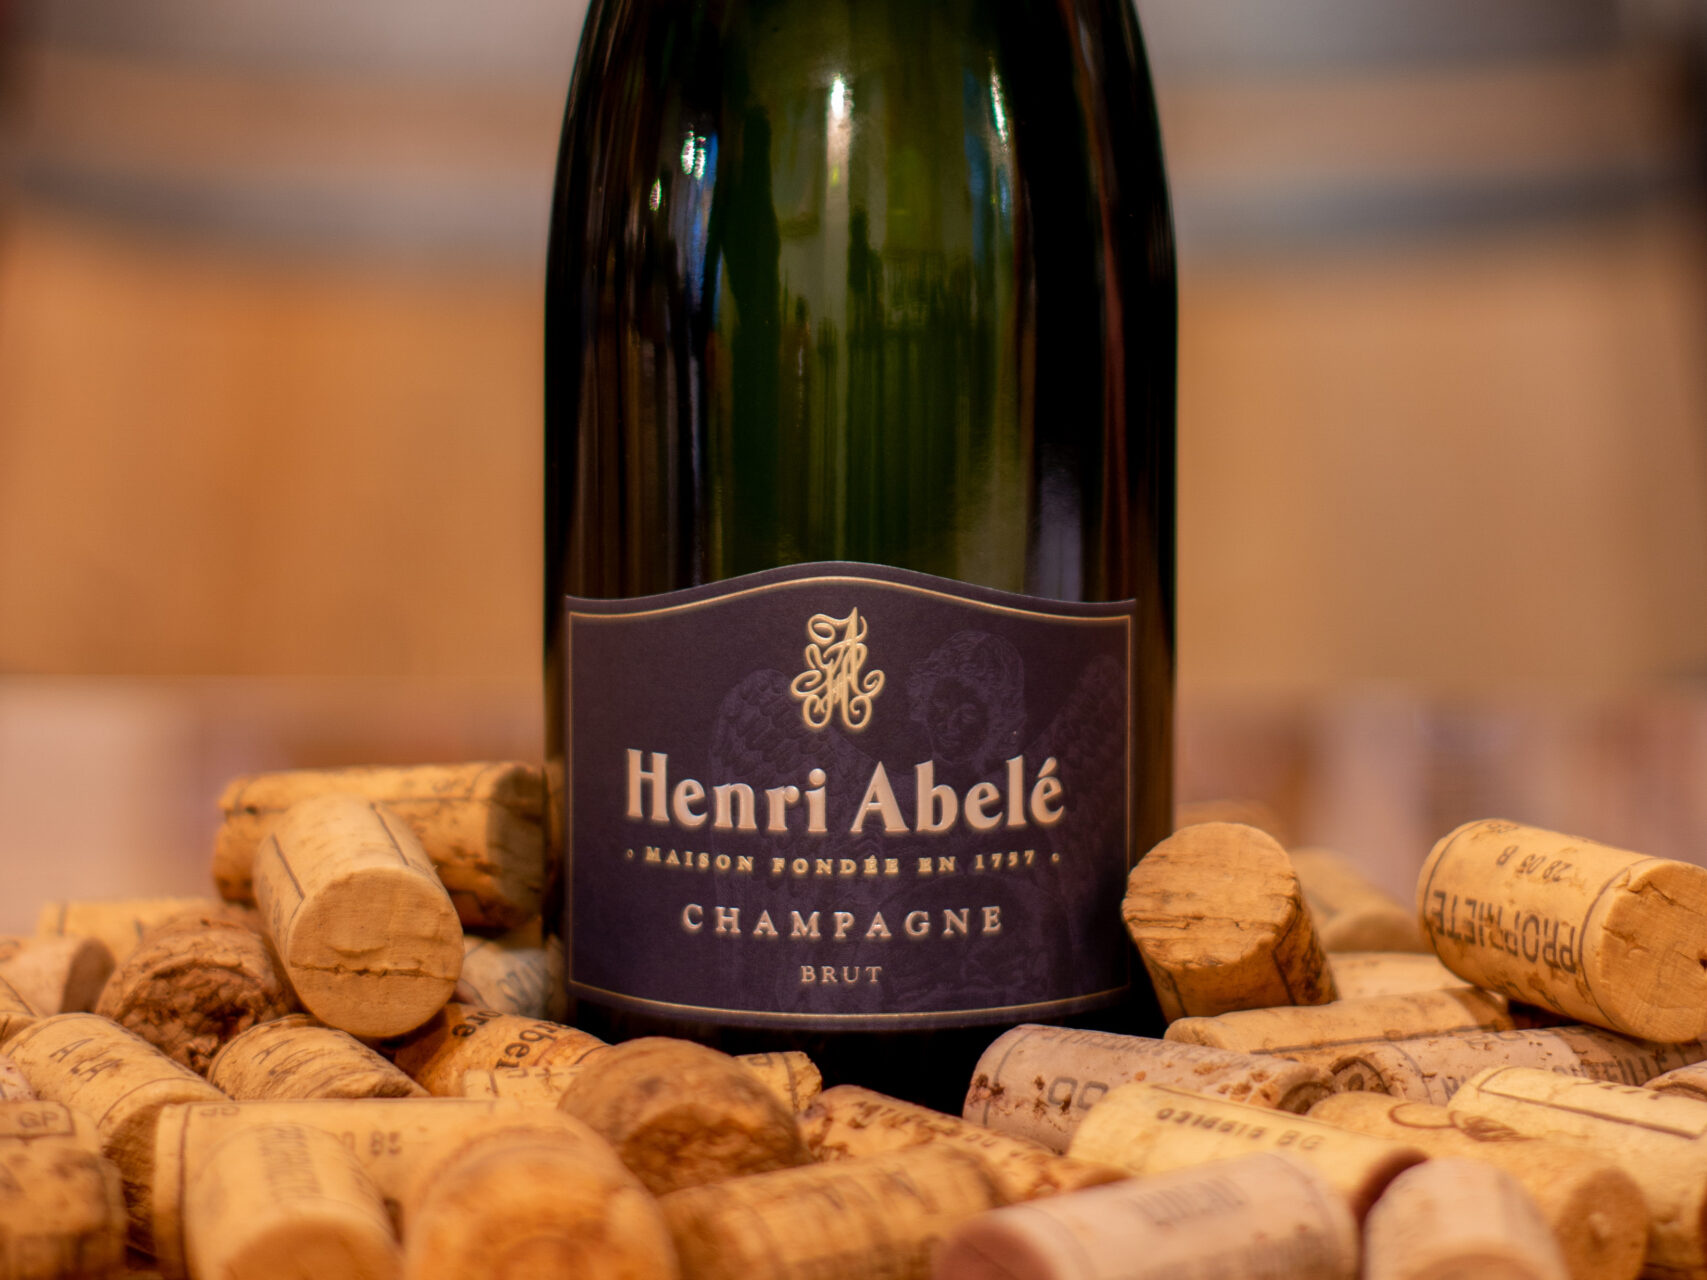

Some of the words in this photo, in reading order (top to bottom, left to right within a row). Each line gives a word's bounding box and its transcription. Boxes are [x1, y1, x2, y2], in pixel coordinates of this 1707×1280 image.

[626, 748, 828, 833] Henri
[850, 755, 1065, 833] Abelé
[644, 846, 754, 873] MAISON
[772, 854, 899, 876] FONDÉE
[917, 856, 957, 873] EN
[974, 849, 1036, 870] 1757
[682, 903, 1003, 940] CHAMPAGNE
[800, 965, 885, 984] BRUT
